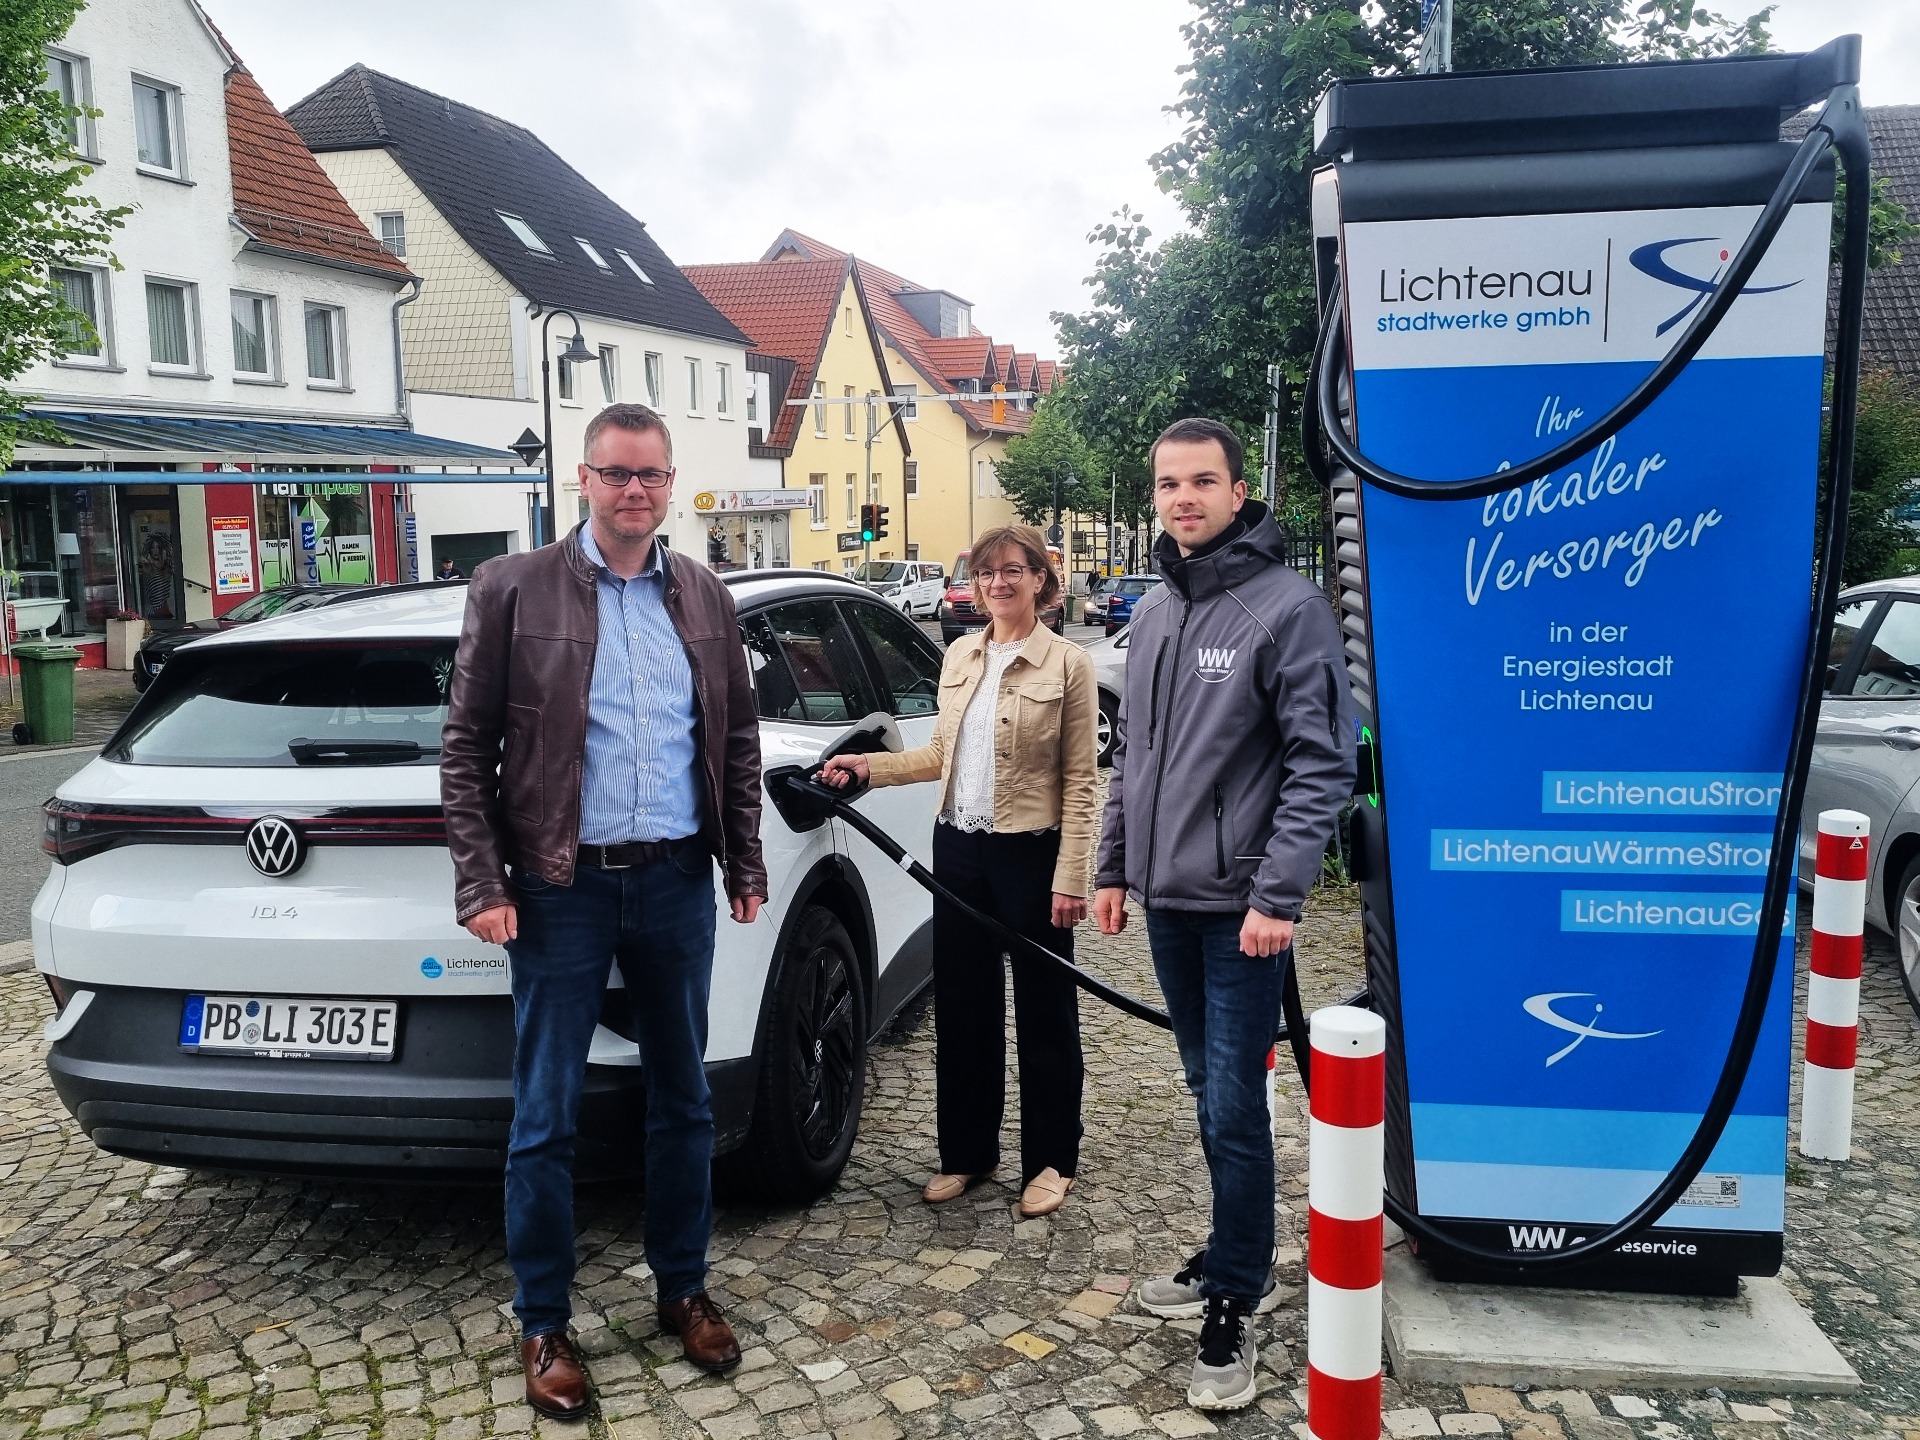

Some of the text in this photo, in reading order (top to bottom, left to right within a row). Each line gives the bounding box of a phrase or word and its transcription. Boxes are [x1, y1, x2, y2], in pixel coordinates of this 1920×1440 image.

[1380, 266, 1592, 303] Lichtenau
[1377, 306, 1590, 333] stadtwerke gmbh
[1535, 396, 1584, 438] Ihr
[1465, 508, 1723, 606] Versorger
[1550, 621, 1628, 643] in der
[1199, 648, 1236, 668] WW
[1503, 655, 1674, 682] Energiestadt
[1520, 689, 1653, 711] Lichtenau
[1443, 838, 1772, 867] LichtenauWärmeStro
[1575, 899, 1791, 927] LichtenauGs
[446, 958, 505, 969] Lichtenau
[203, 1002, 242, 1040] PB
[262, 1003, 300, 1043] LI
[1508, 1226, 1567, 1249] WW
